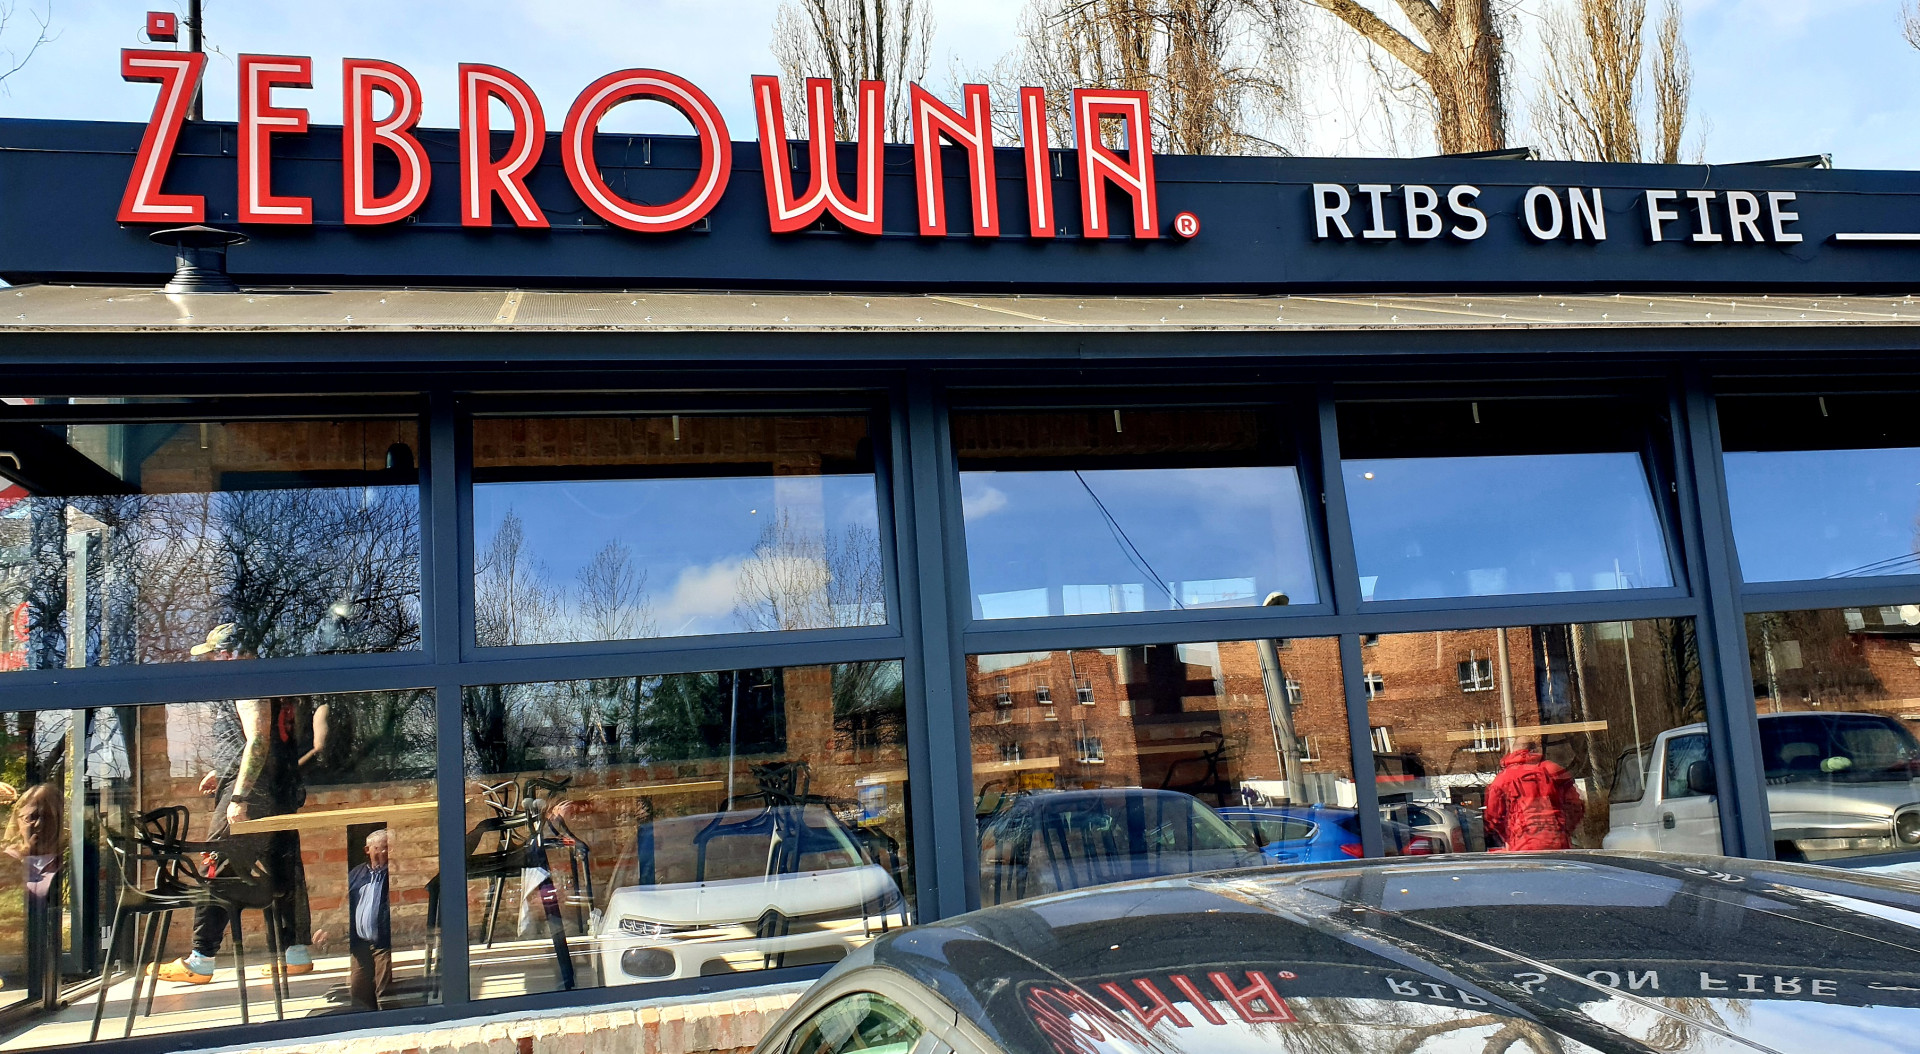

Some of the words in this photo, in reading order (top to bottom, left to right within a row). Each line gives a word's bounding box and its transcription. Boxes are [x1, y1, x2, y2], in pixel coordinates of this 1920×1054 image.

[116, 11, 1159, 238] ŻEBROWNIA
[1312, 183, 1488, 240] RIBS
[1524, 186, 1606, 240] ON
[1646, 190, 1803, 242] FIRE
